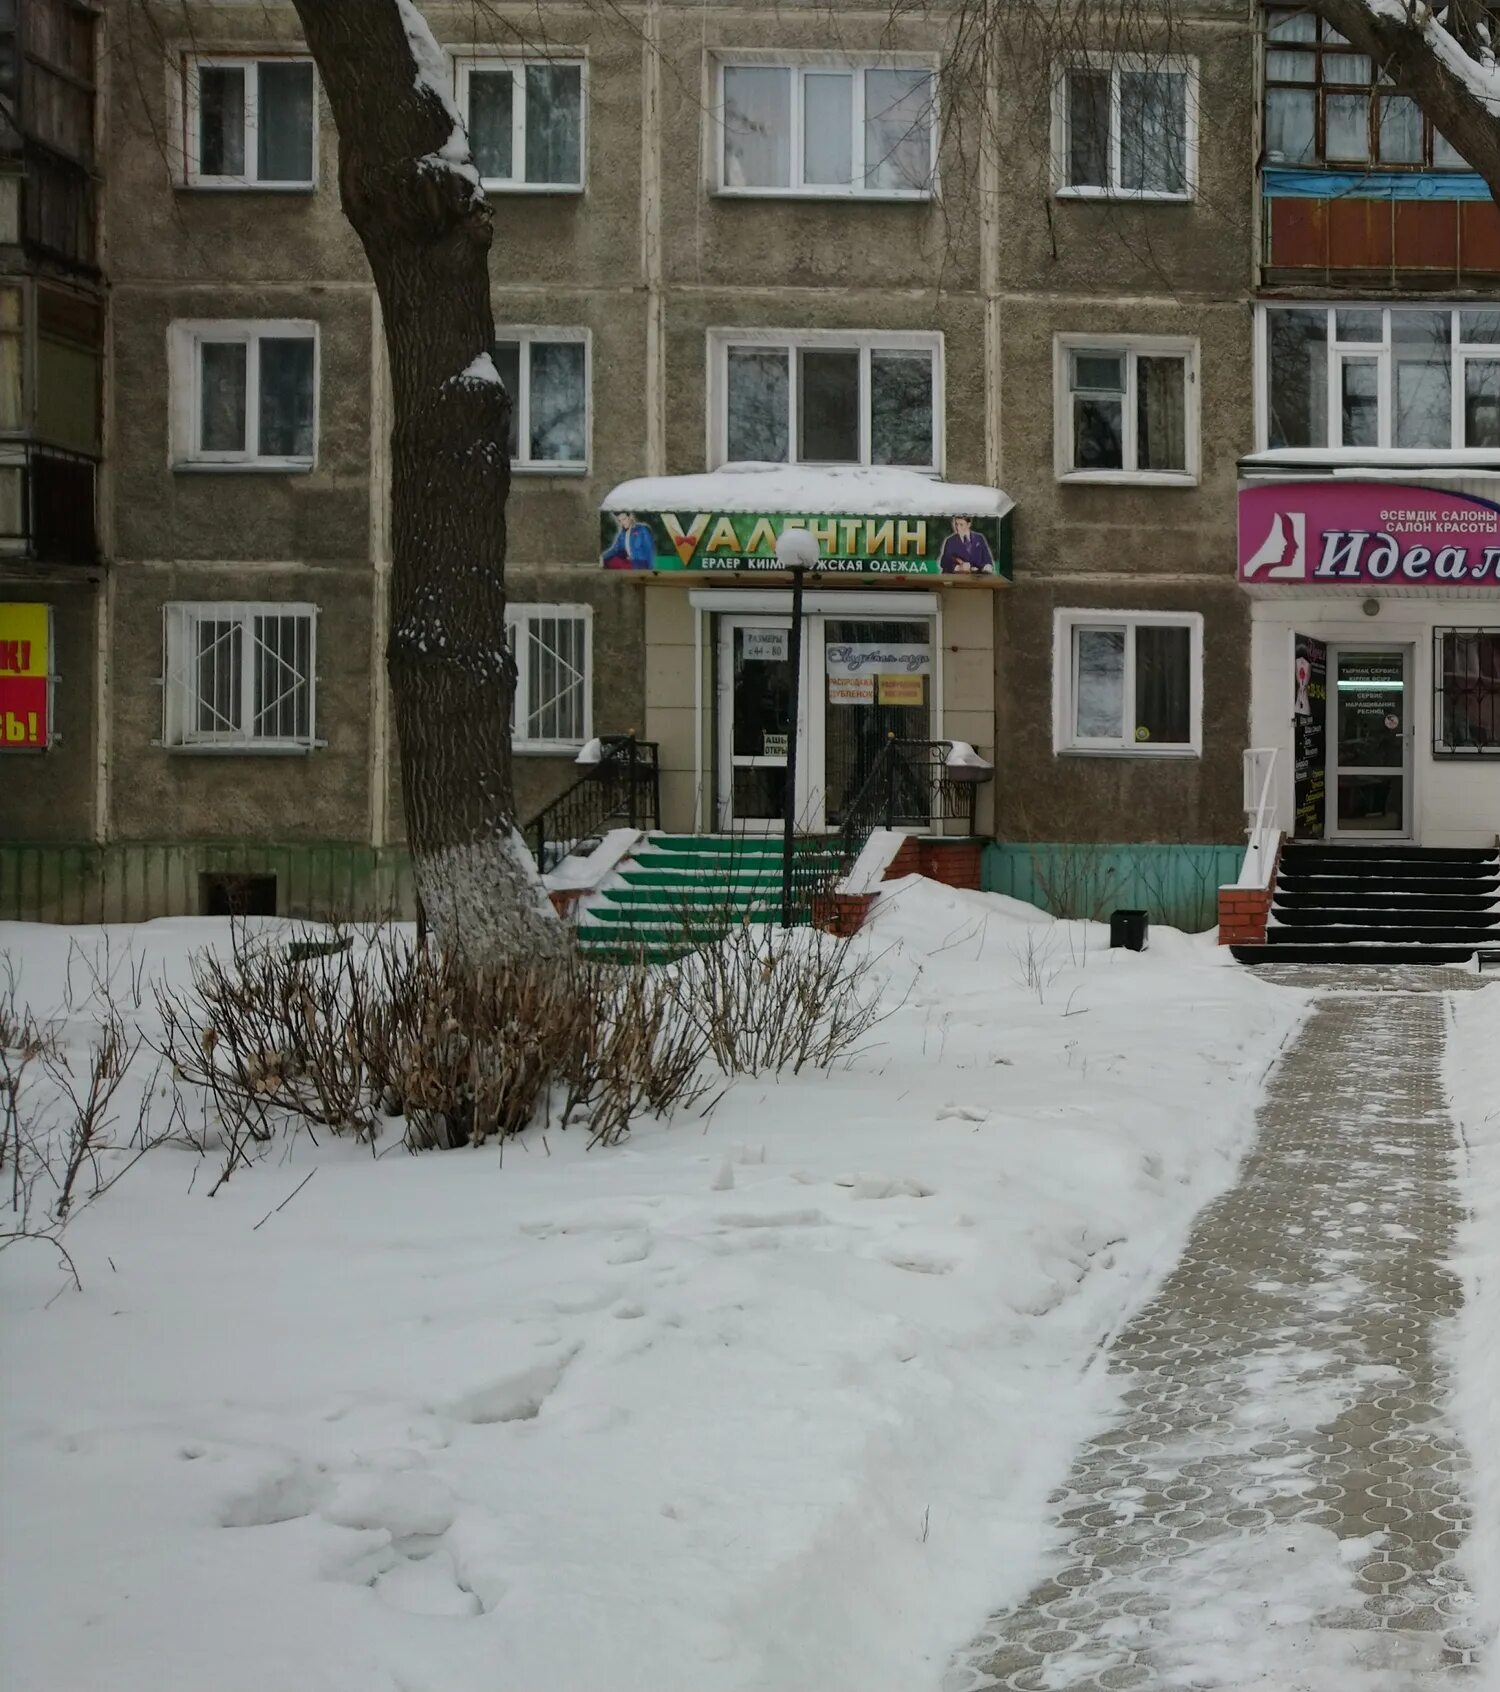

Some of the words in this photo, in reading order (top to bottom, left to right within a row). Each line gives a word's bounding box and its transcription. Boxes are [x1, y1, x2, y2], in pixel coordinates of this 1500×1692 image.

[1379, 511, 1437, 523] ӘСЕМДІК
[1441, 510, 1498, 522] САЛОНЫ
[1385, 522, 1433, 533] САЛОН
[1435, 522, 1498, 533] КРАСОТЫ
[701, 557, 741, 569] ЕРЛЕР
[869, 561, 929, 573] ОДЕЖДА
